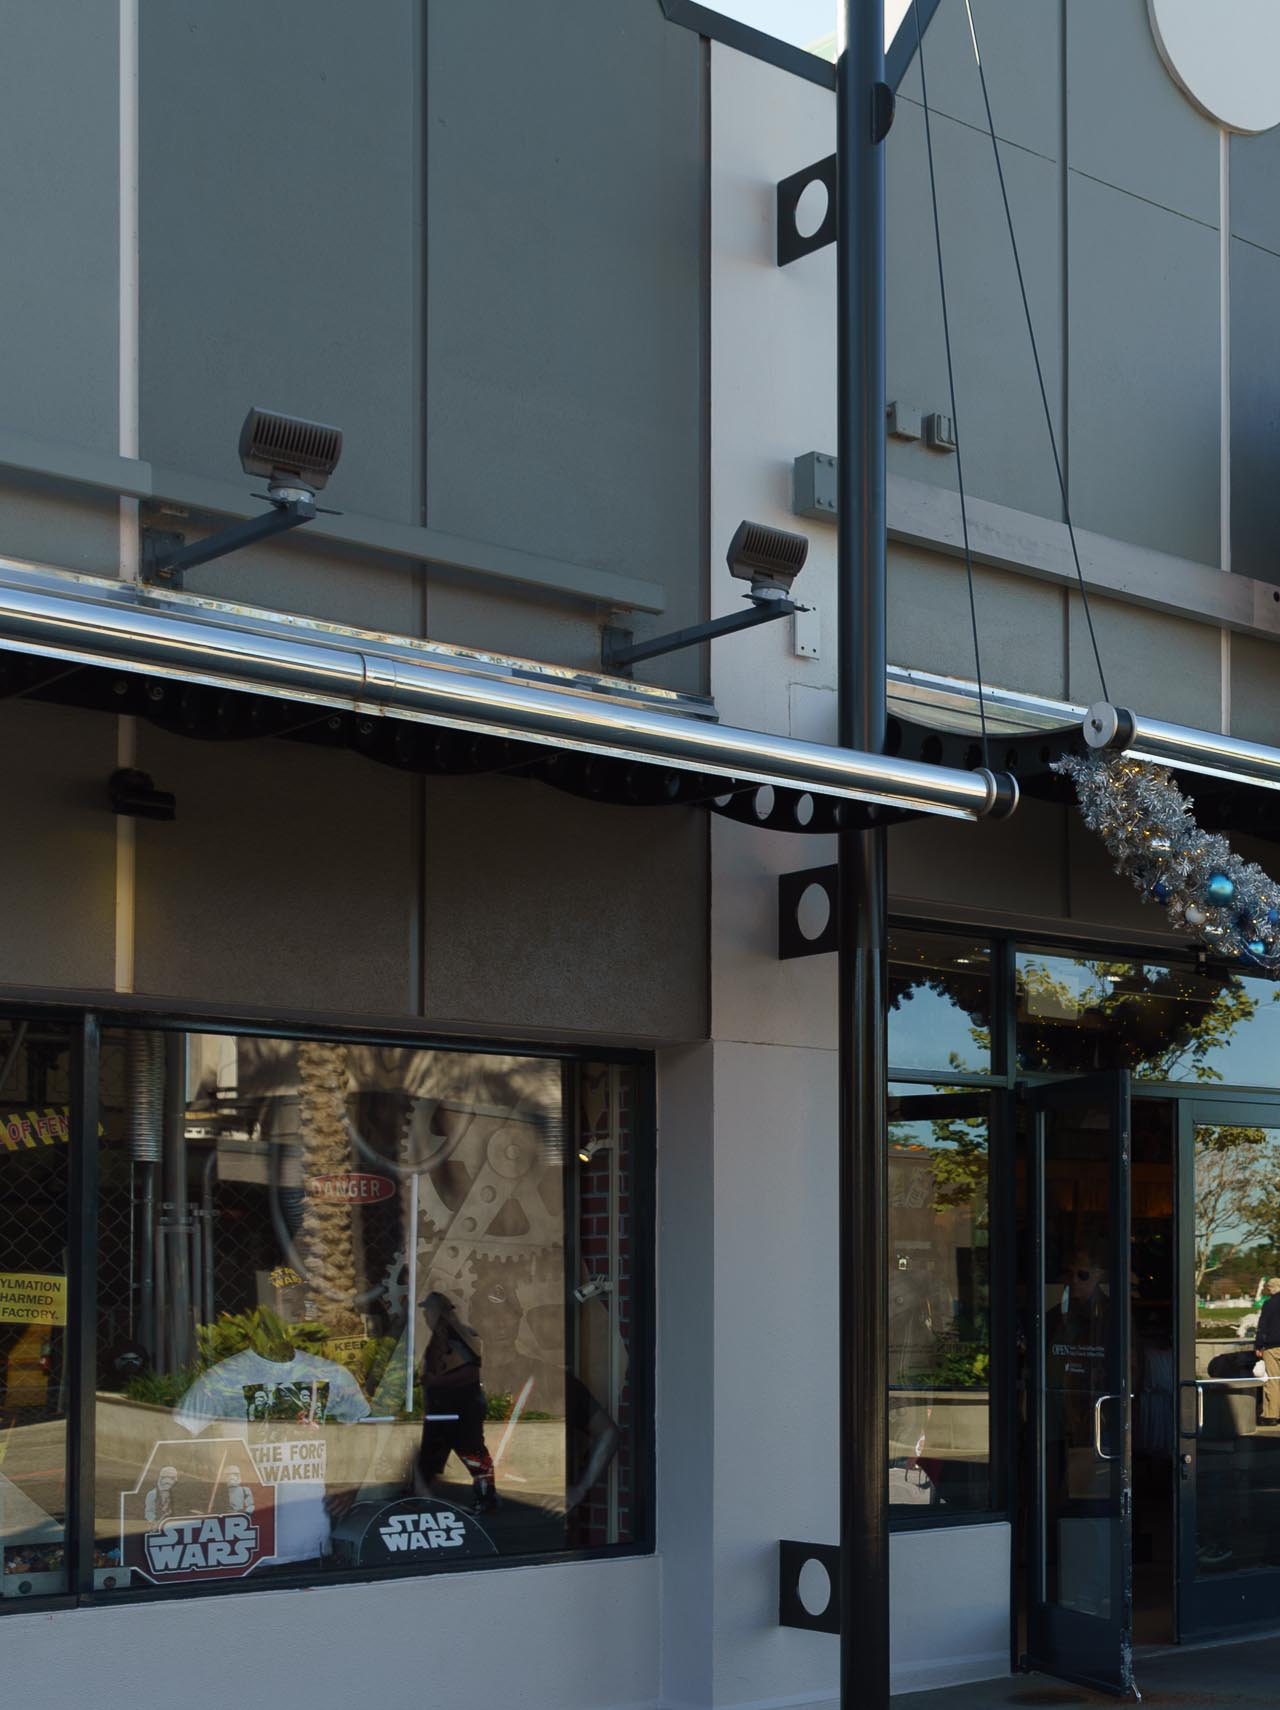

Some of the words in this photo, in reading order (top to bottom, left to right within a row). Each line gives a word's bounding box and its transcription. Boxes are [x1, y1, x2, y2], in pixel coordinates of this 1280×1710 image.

[311, 1180, 380, 1197] DANGER
[2, 1307, 59, 1320] FACTORY.
[250, 1446, 283, 1463] THE
[150, 1516, 256, 1545] STAR
[379, 1511, 464, 1533] STAR
[381, 1528, 466, 1552] WARS
[150, 1540, 256, 1570] WARS
